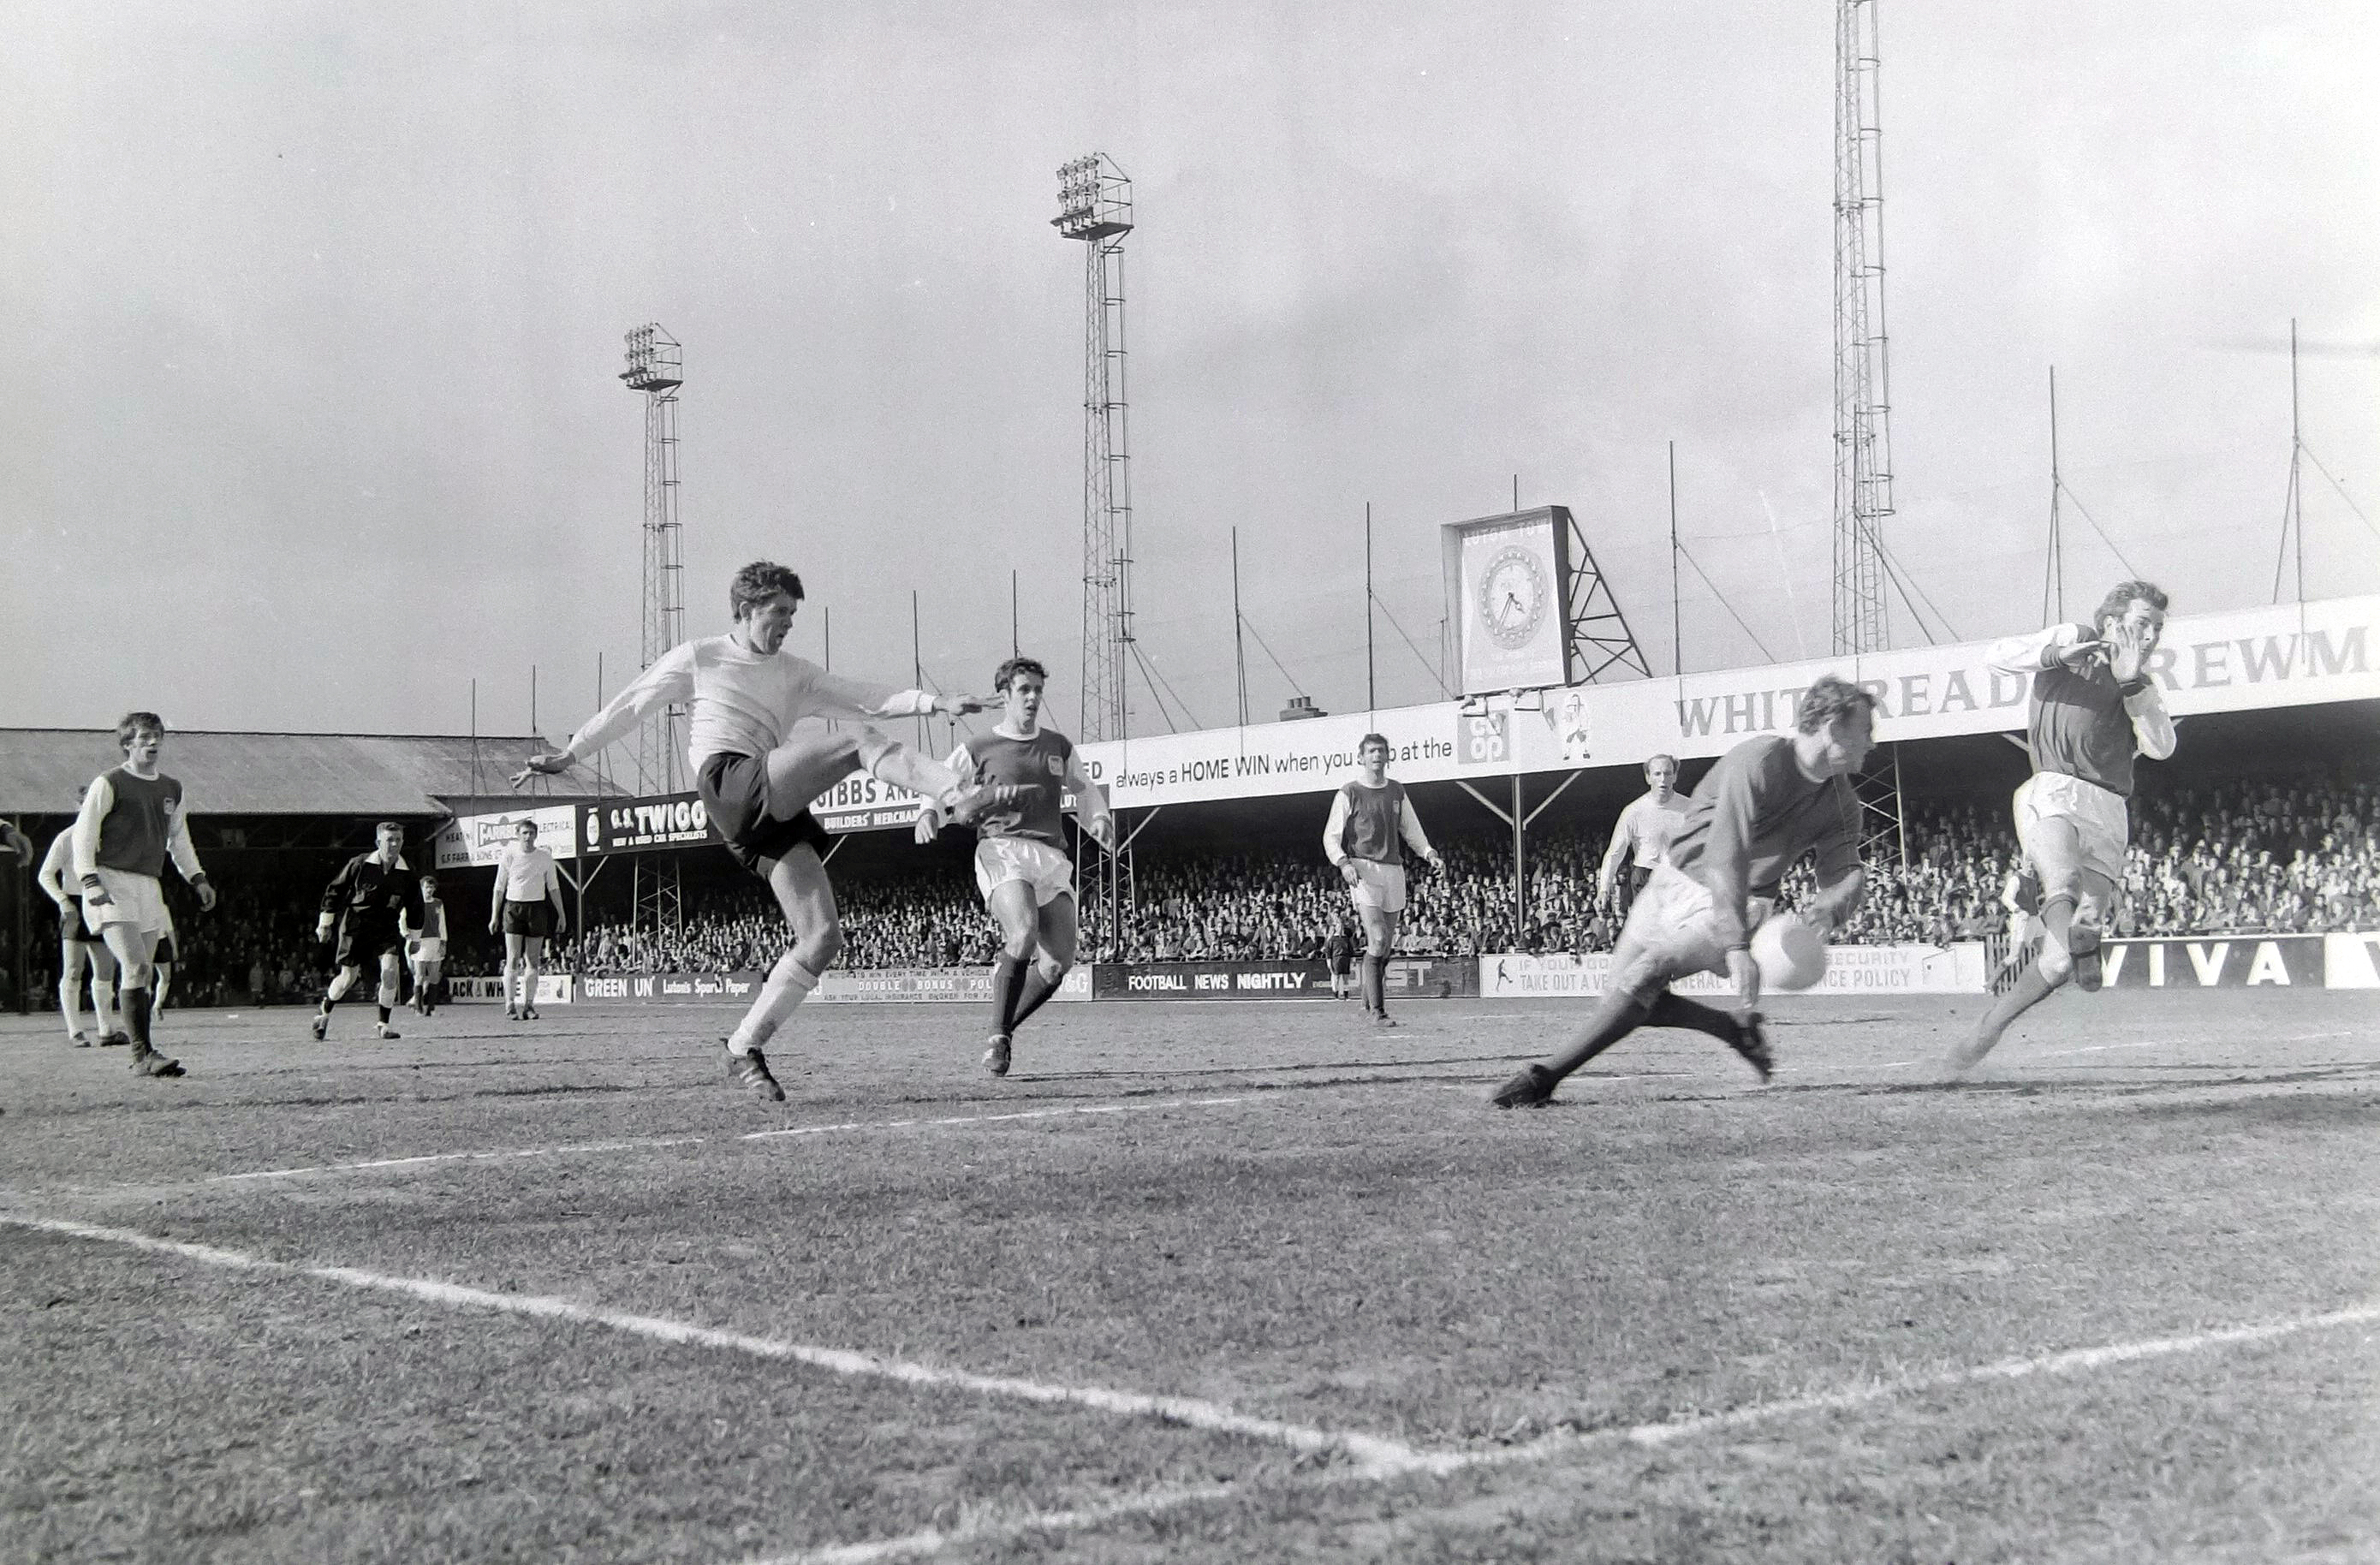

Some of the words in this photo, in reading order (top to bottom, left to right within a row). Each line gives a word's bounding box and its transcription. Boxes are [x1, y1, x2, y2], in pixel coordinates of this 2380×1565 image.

[1674, 669, 2027, 738] WHITREAD
[2142, 625, 2380, 691] REWM
[1116, 768, 1165, 790] always
[1169, 771, 1176, 783] a
[1181, 758, 1229, 782] HOME
[1235, 754, 1270, 777] WIN
[1275, 758, 1319, 774] when
[1324, 751, 1353, 775] you
[1400, 742, 1419, 761] at
[1425, 737, 1452, 759] the
[873, 809, 919, 825] MERCHAN
[452, 981, 473, 997] ACK
[485, 980, 521, 997] WHE
[726, 979, 751, 997] Paper
[859, 980, 900, 991] DOUBLE
[917, 979, 953, 991] BONUS
[970, 979, 992, 989] POL
[1128, 974, 1187, 991] FOOTBALL
[1194, 973, 1229, 990] NEWS
[1237, 972, 1306, 990] NIGHTLY
[1520, 974, 1548, 991] TAKE
[1553, 974, 1576, 991] OUT
[1580, 974, 1589, 990] A
[1853, 968, 1910, 987] POLICY
